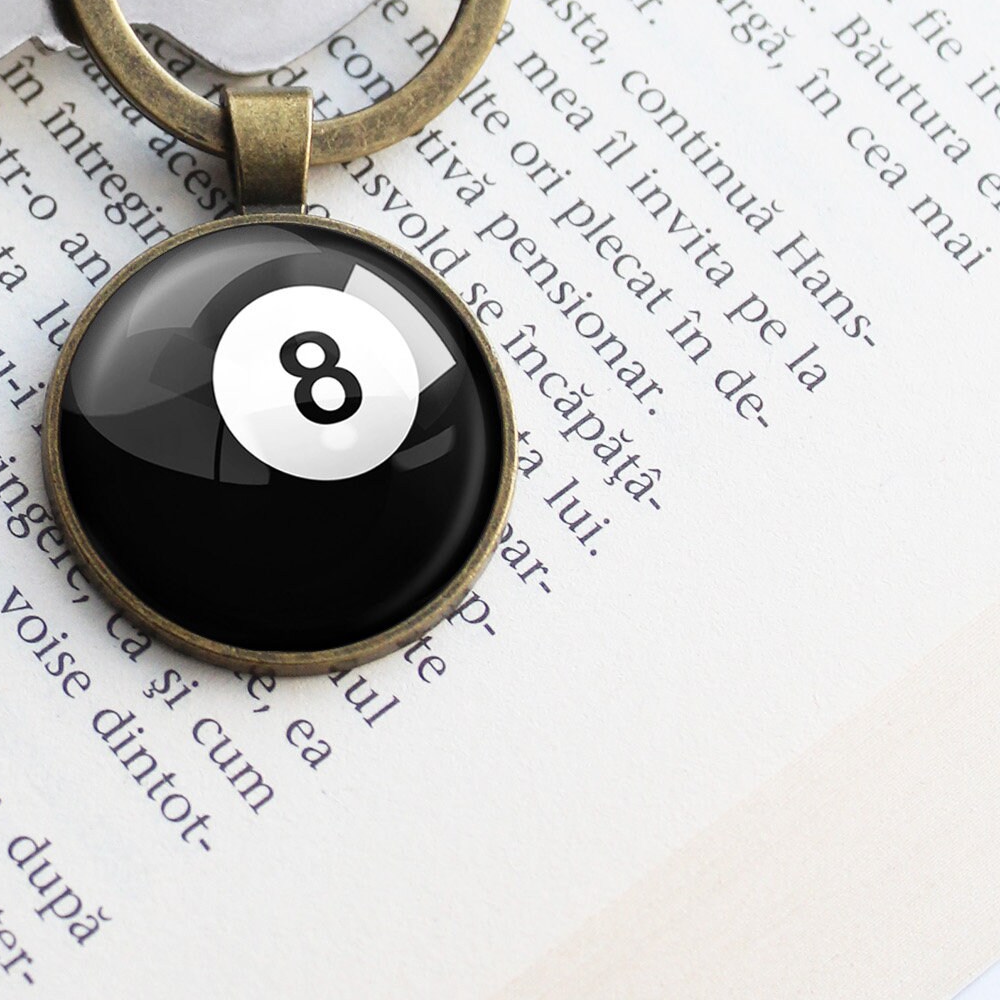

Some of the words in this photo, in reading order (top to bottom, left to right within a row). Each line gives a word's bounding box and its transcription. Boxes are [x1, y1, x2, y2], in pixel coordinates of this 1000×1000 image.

[830, 14, 972, 166] Băutura
[909, 8, 964, 62] fie
[513, 49, 595, 133] mea
[592, 129, 639, 170] îl
[625, 167, 736, 290] invita
[722, 291, 788, 347] pe
[784, 341, 828, 394] la
[620, 69, 785, 236] continuă
[772, 230, 876, 348] Hans-
[795, 67, 843, 120] în
[846, 125, 909, 191] cea
[907, 192, 993, 275] mai
[472, 211, 665, 417] pensionar.
[509, 140, 572, 197] ori
[549, 196, 674, 315] plecat
[665, 309, 713, 366] în
[713, 369, 770, 429] de-
[277, 329, 364, 426] 8
[454, 281, 505, 328] se
[500, 323, 663, 512] încăpăţâ-
[542, 475, 611, 558] lui.
[0, 584, 92, 700] voise
[91, 708, 212, 853] dintot-
[141, 668, 200, 711] şi
[191, 717, 275, 816] cum
[284, 718, 333, 772] ea
[6, 834, 113, 947] după
